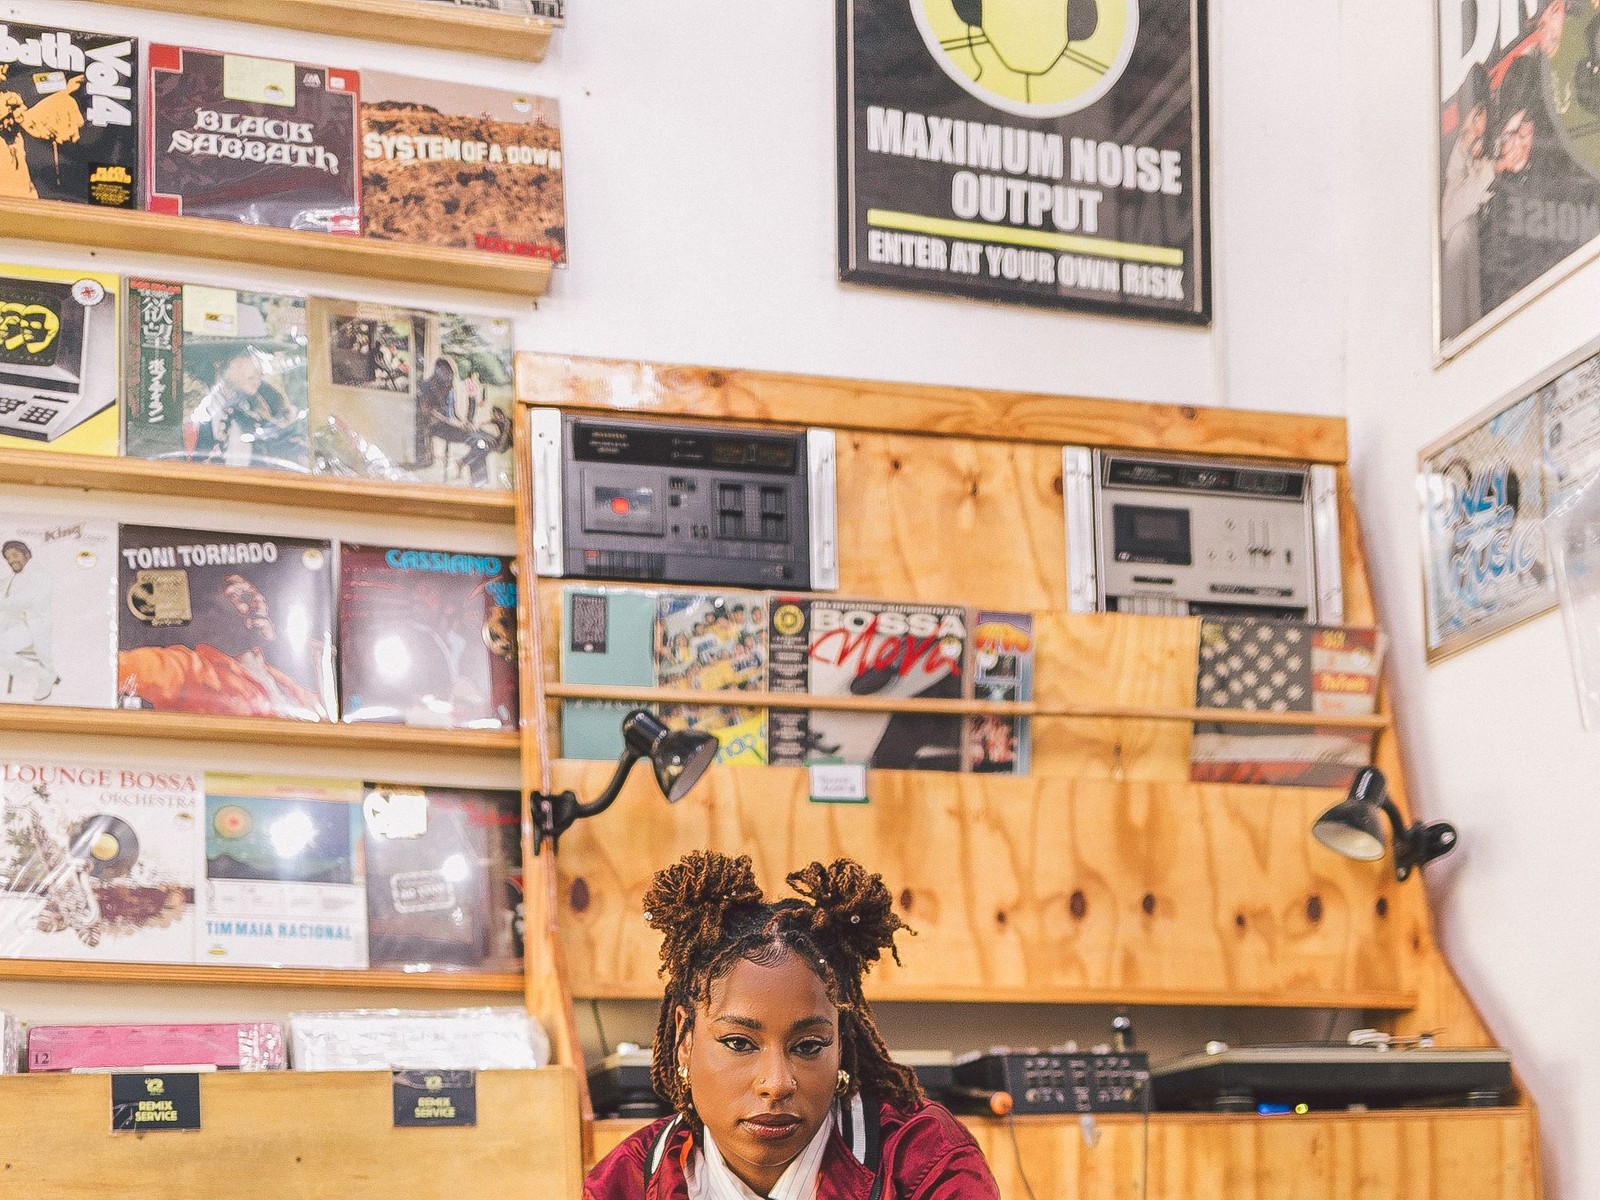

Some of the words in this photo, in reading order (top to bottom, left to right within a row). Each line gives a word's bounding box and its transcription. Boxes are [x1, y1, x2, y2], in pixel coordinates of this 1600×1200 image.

[193, 107, 315, 144] BLACK
[363, 131, 461, 164] SYSTEM
[461, 140, 488, 164] OF
[488, 143, 504, 164] A
[506, 145, 561, 170] DOWN
[867, 105, 1063, 180] MAXIMUM
[1070, 137, 1183, 196] NOISE
[951, 171, 1102, 233] OUTPUT
[867, 229, 948, 272] ENTER
[949, 241, 984, 275] AT
[985, 246, 1056, 284] YOUR
[1057, 255, 1120, 294] OWN
[1122, 263, 1185, 301] RISK
[122, 545, 177, 569] TONI
[177, 541, 278, 568] TORNADO
[384, 549, 502, 577] CASSIANO
[811, 607, 967, 638] BOSSA
[3, 763, 112, 788] LOUNGE
[119, 770, 197, 793] BOSSA
[99, 791, 196, 809] ORCHESTRA
[206, 920, 232, 935] TIM
[235, 922, 274, 937] MAIA
[277, 923, 353, 942] RACIONAL
[33, 1052, 50, 1065] 12
[138, 1100, 173, 1111] REMIX
[414, 1106, 456, 1118] SERVICE
[417, 1096, 451, 1107] REMIX
[134, 1111, 178, 1122] SERVICE
